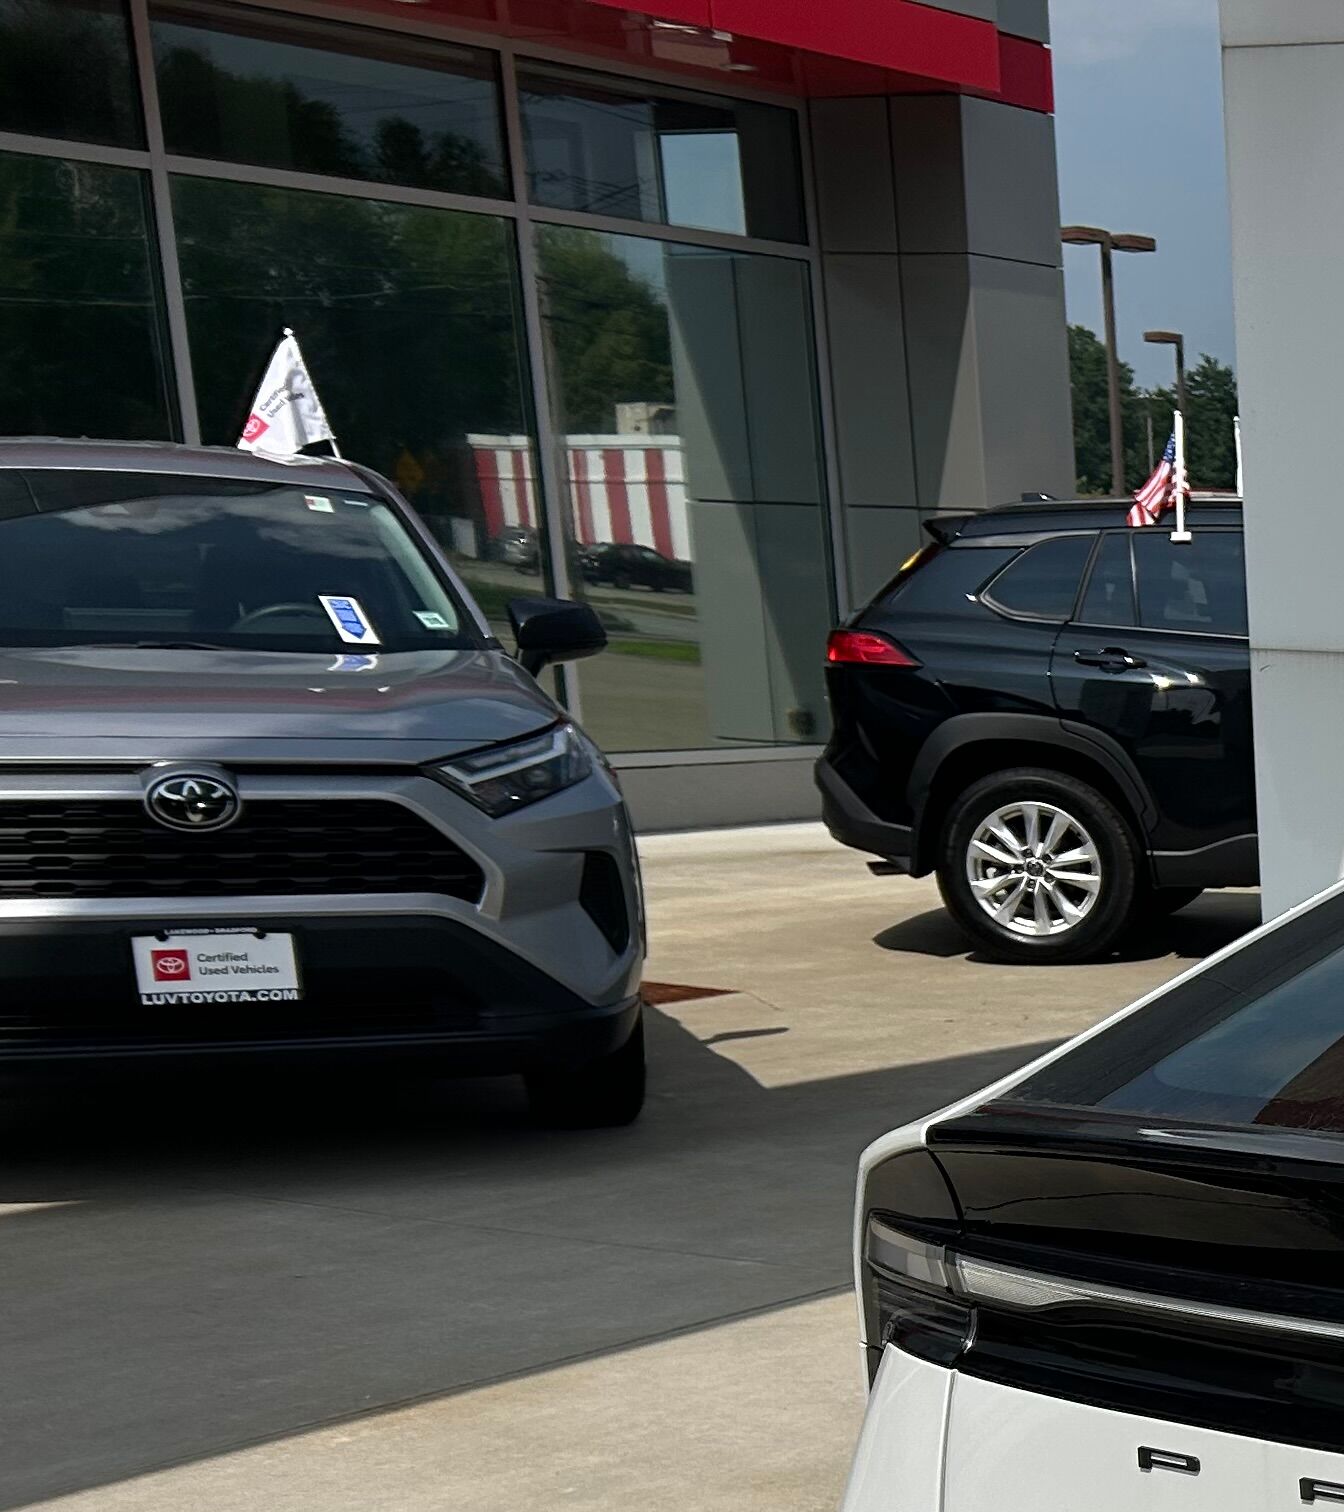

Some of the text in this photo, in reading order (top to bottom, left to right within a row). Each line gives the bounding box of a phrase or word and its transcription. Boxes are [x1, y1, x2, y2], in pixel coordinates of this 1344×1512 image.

[197, 952, 249, 963] Certified
[200, 964, 280, 976] Used Vehicles
[140, 988, 299, 1006] LUVTOYOTA.COM
